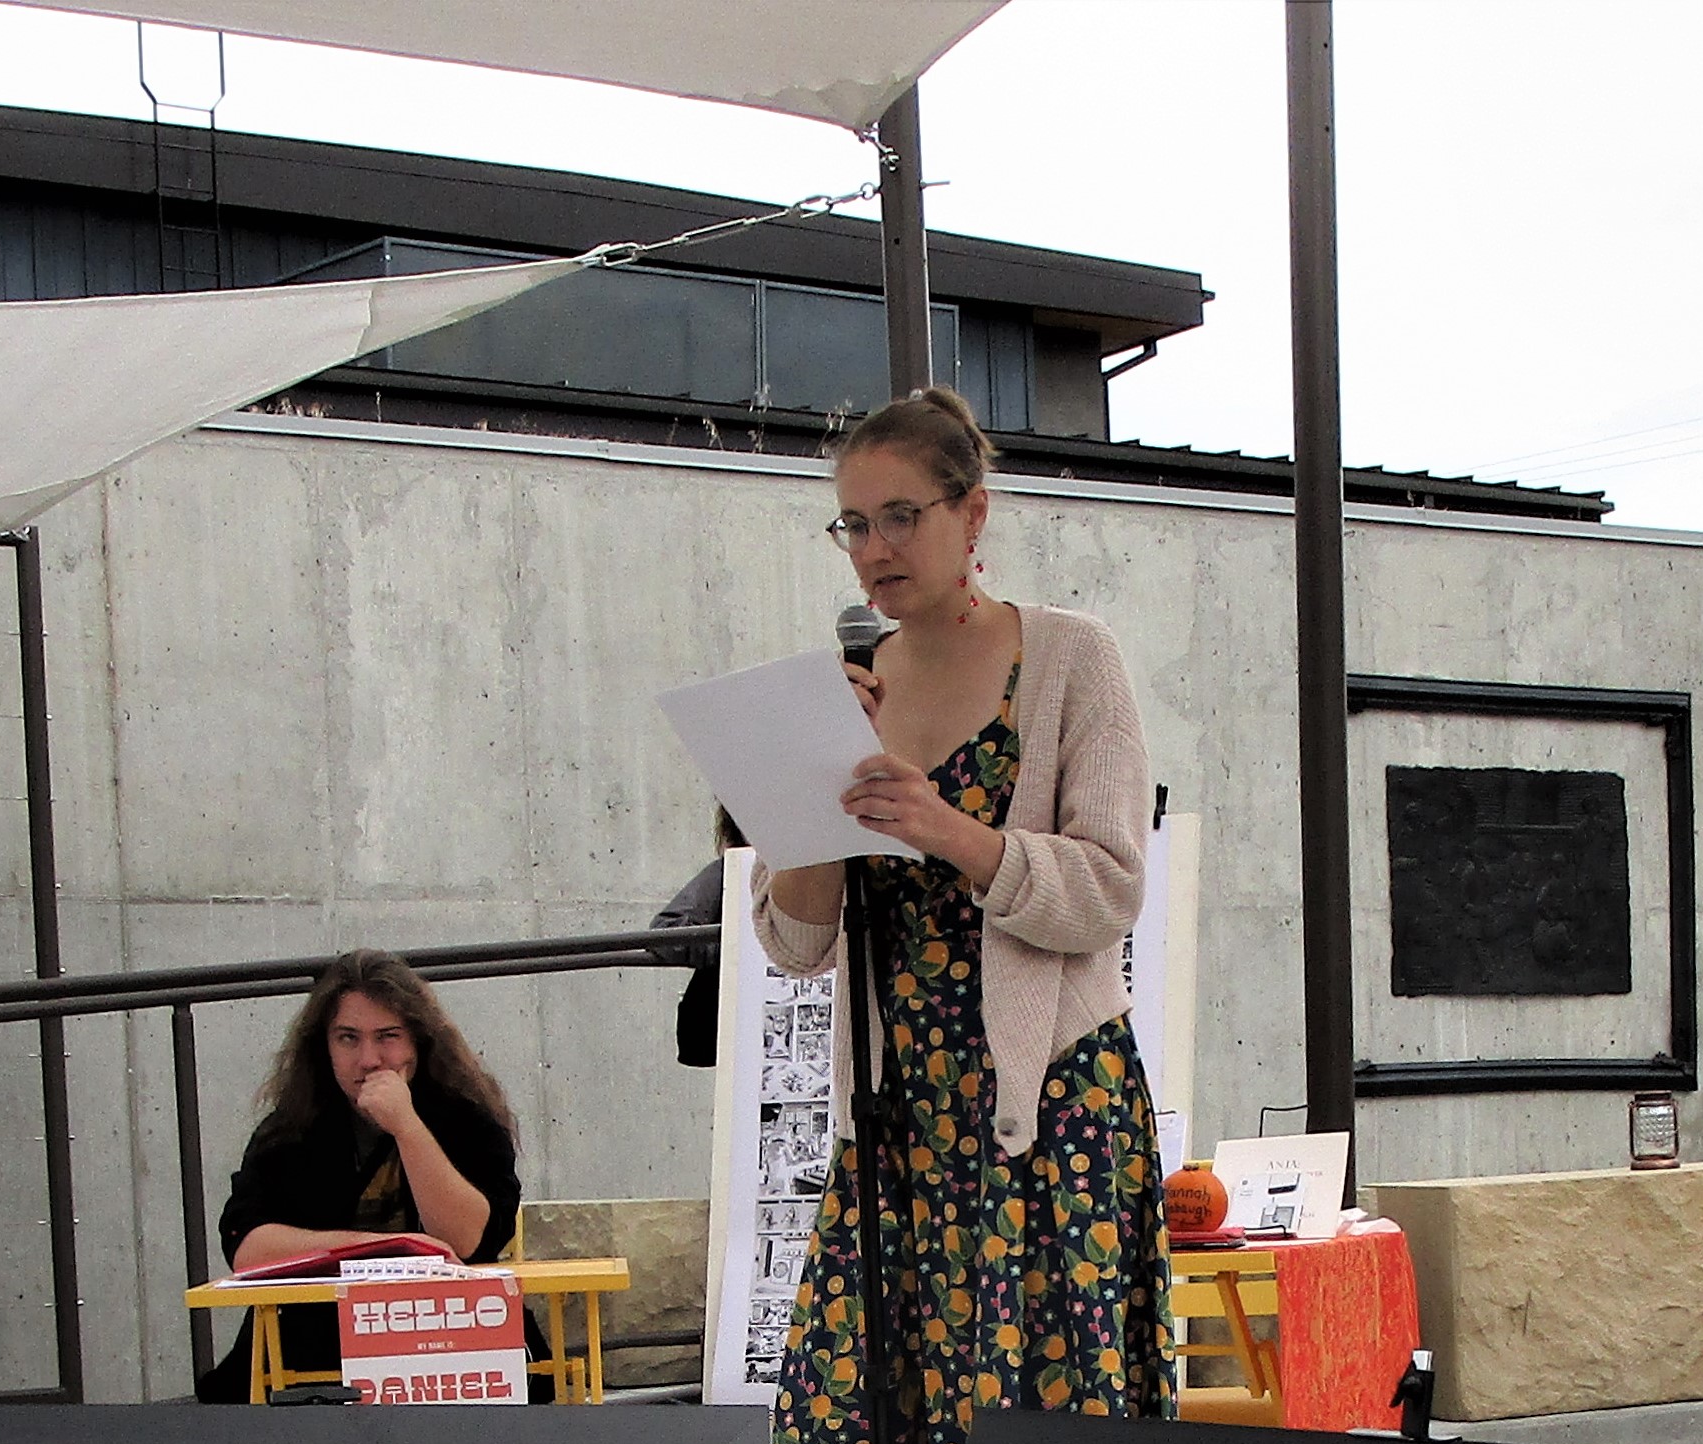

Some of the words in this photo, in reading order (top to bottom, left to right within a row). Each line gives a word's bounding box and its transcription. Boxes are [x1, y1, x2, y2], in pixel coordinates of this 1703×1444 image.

[1166, 1185, 1211, 1205] annah
[352, 1295, 508, 1336] HELLO
[350, 1370, 513, 1405] DANIEL
